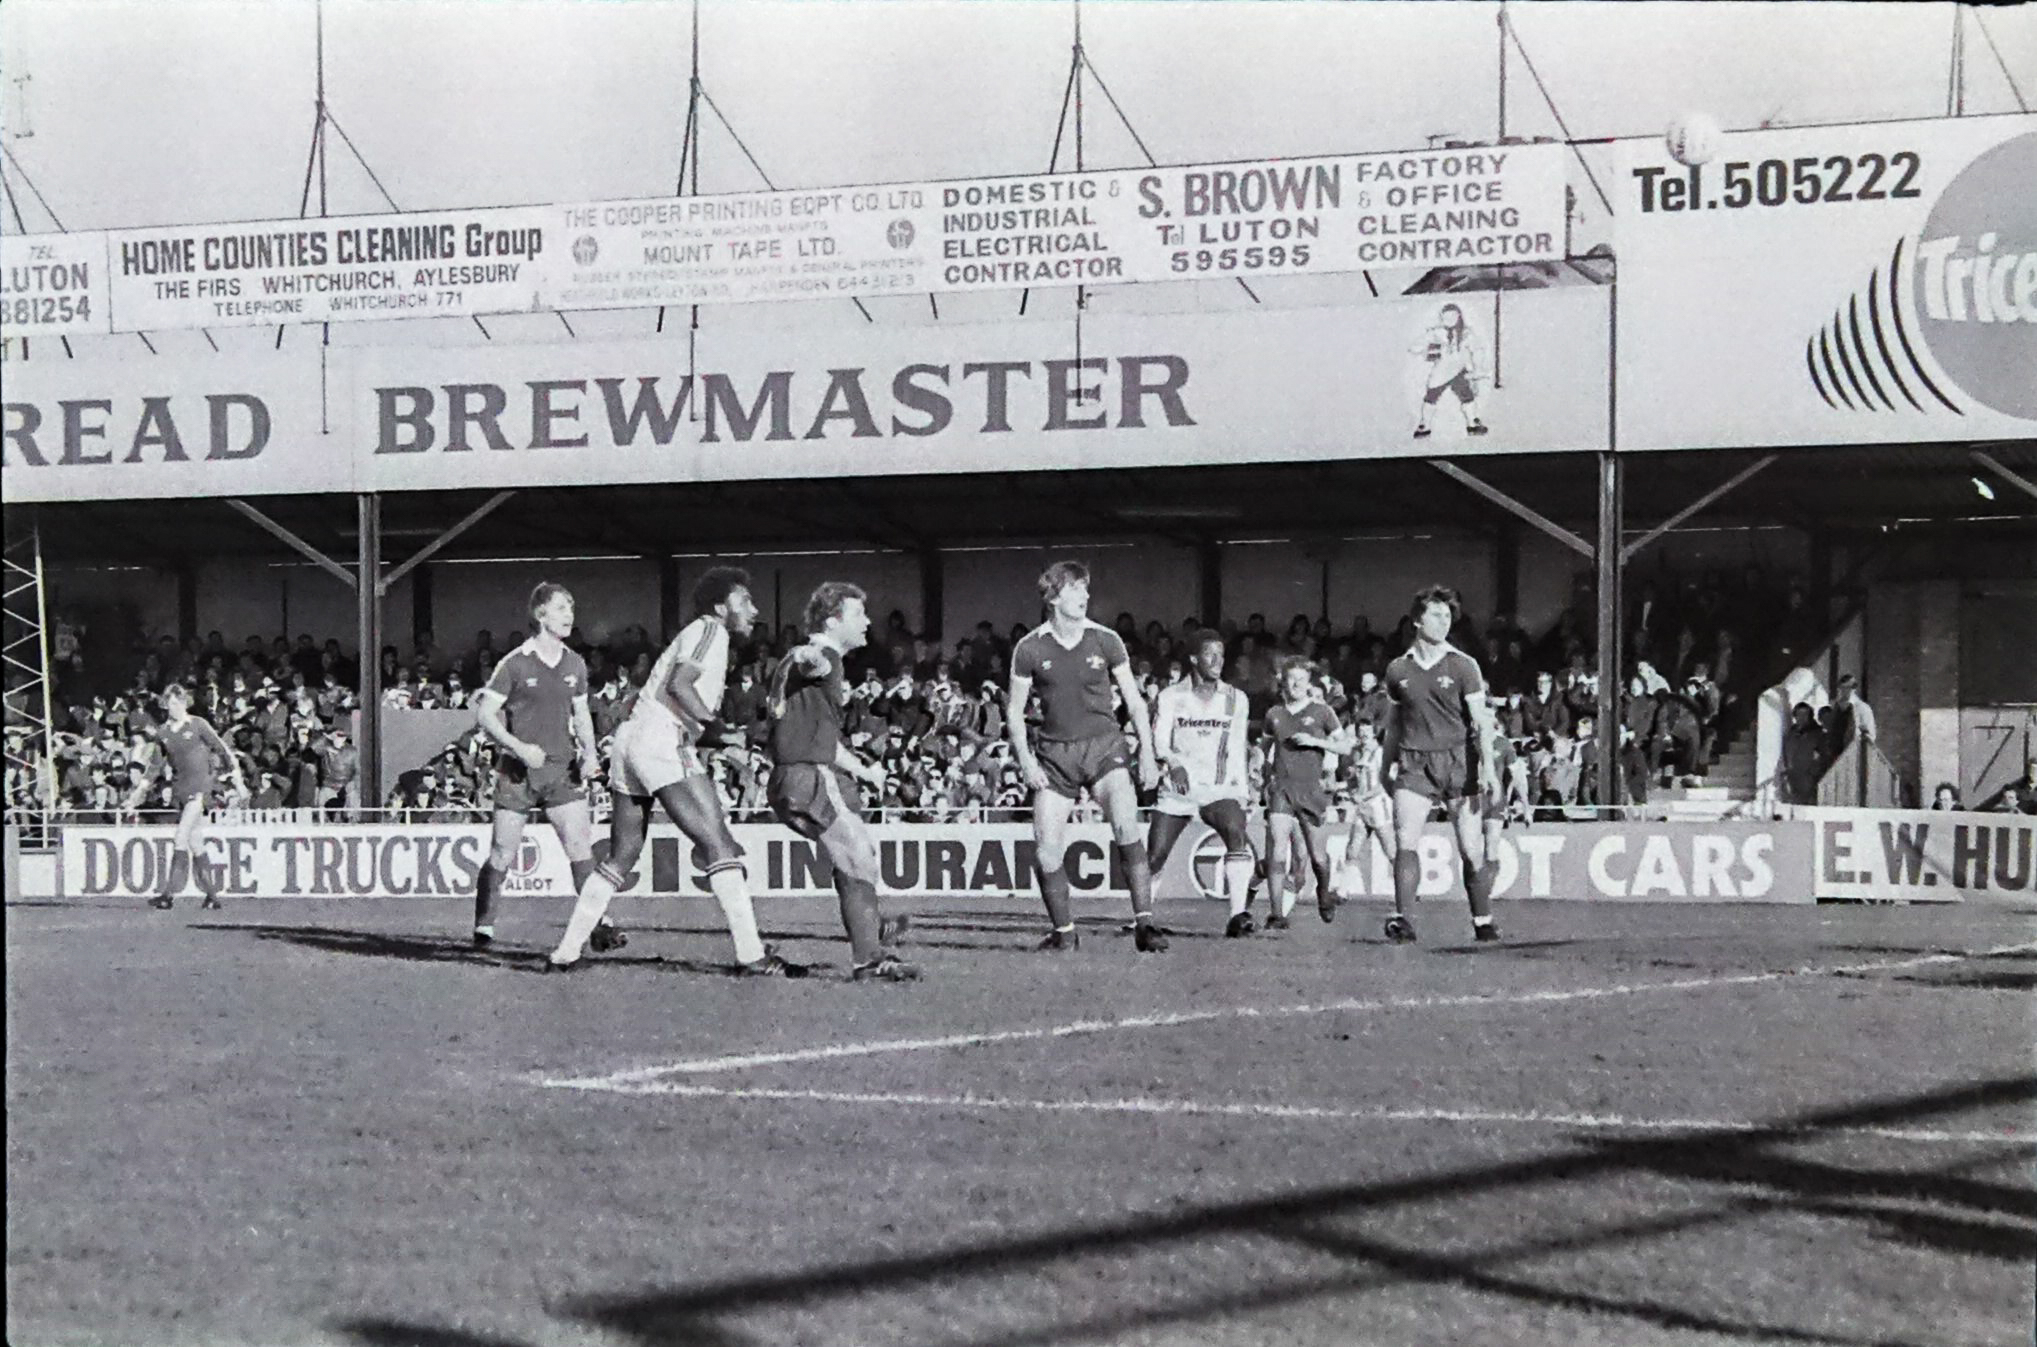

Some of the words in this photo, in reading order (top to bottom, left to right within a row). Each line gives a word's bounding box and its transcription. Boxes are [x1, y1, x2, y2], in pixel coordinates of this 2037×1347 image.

[1357, 154, 1507, 182] FACTORY
[943, 179, 1097, 208] DOMESTIC
[1108, 179, 1121, 198] &
[1138, 175, 1171, 219] S.
[1184, 164, 1340, 217] BROWN
[1358, 190, 1371, 208] &
[1386, 181, 1502, 207] OFFICE
[564, 208, 598, 228] THE
[604, 204, 682, 226] COOPER
[688, 198, 783, 222] PRINTING
[790, 194, 842, 216] EQPT
[943, 206, 1097, 233] INDUSTRIAL
[1357, 207, 1520, 235] CLEANING
[1199, 216, 1319, 244] LUTON
[122, 238, 196, 276] HOME
[203, 231, 328, 271] COUNTIES
[337, 224, 455, 265] CLEANING
[465, 223, 543, 261] Group
[643, 243, 714, 266] MOUNT
[728, 238, 783, 260] TAPE
[943, 232, 1108, 259] ELECTRICAL
[1171, 245, 1310, 272] 595595
[1357, 232, 1553, 262] CONTRACTOR
[154, 281, 190, 300] THE
[197, 278, 241, 297] FIRS
[413, 263, 520, 286] AYLESBURY
[944, 256, 1123, 284] CONTRACTOR
[213, 299, 303, 317] TELEPHONE
[329, 293, 428, 311] WHITCHURCH
[436, 291, 463, 306] 771
[374, 354, 1197, 455] BREWMASTER
[81, 836, 258, 895] DODGE
[271, 835, 480, 895] TRUCKS
[1588, 833, 1775, 898] CARS
[504, 877, 553, 891] ALBOT
